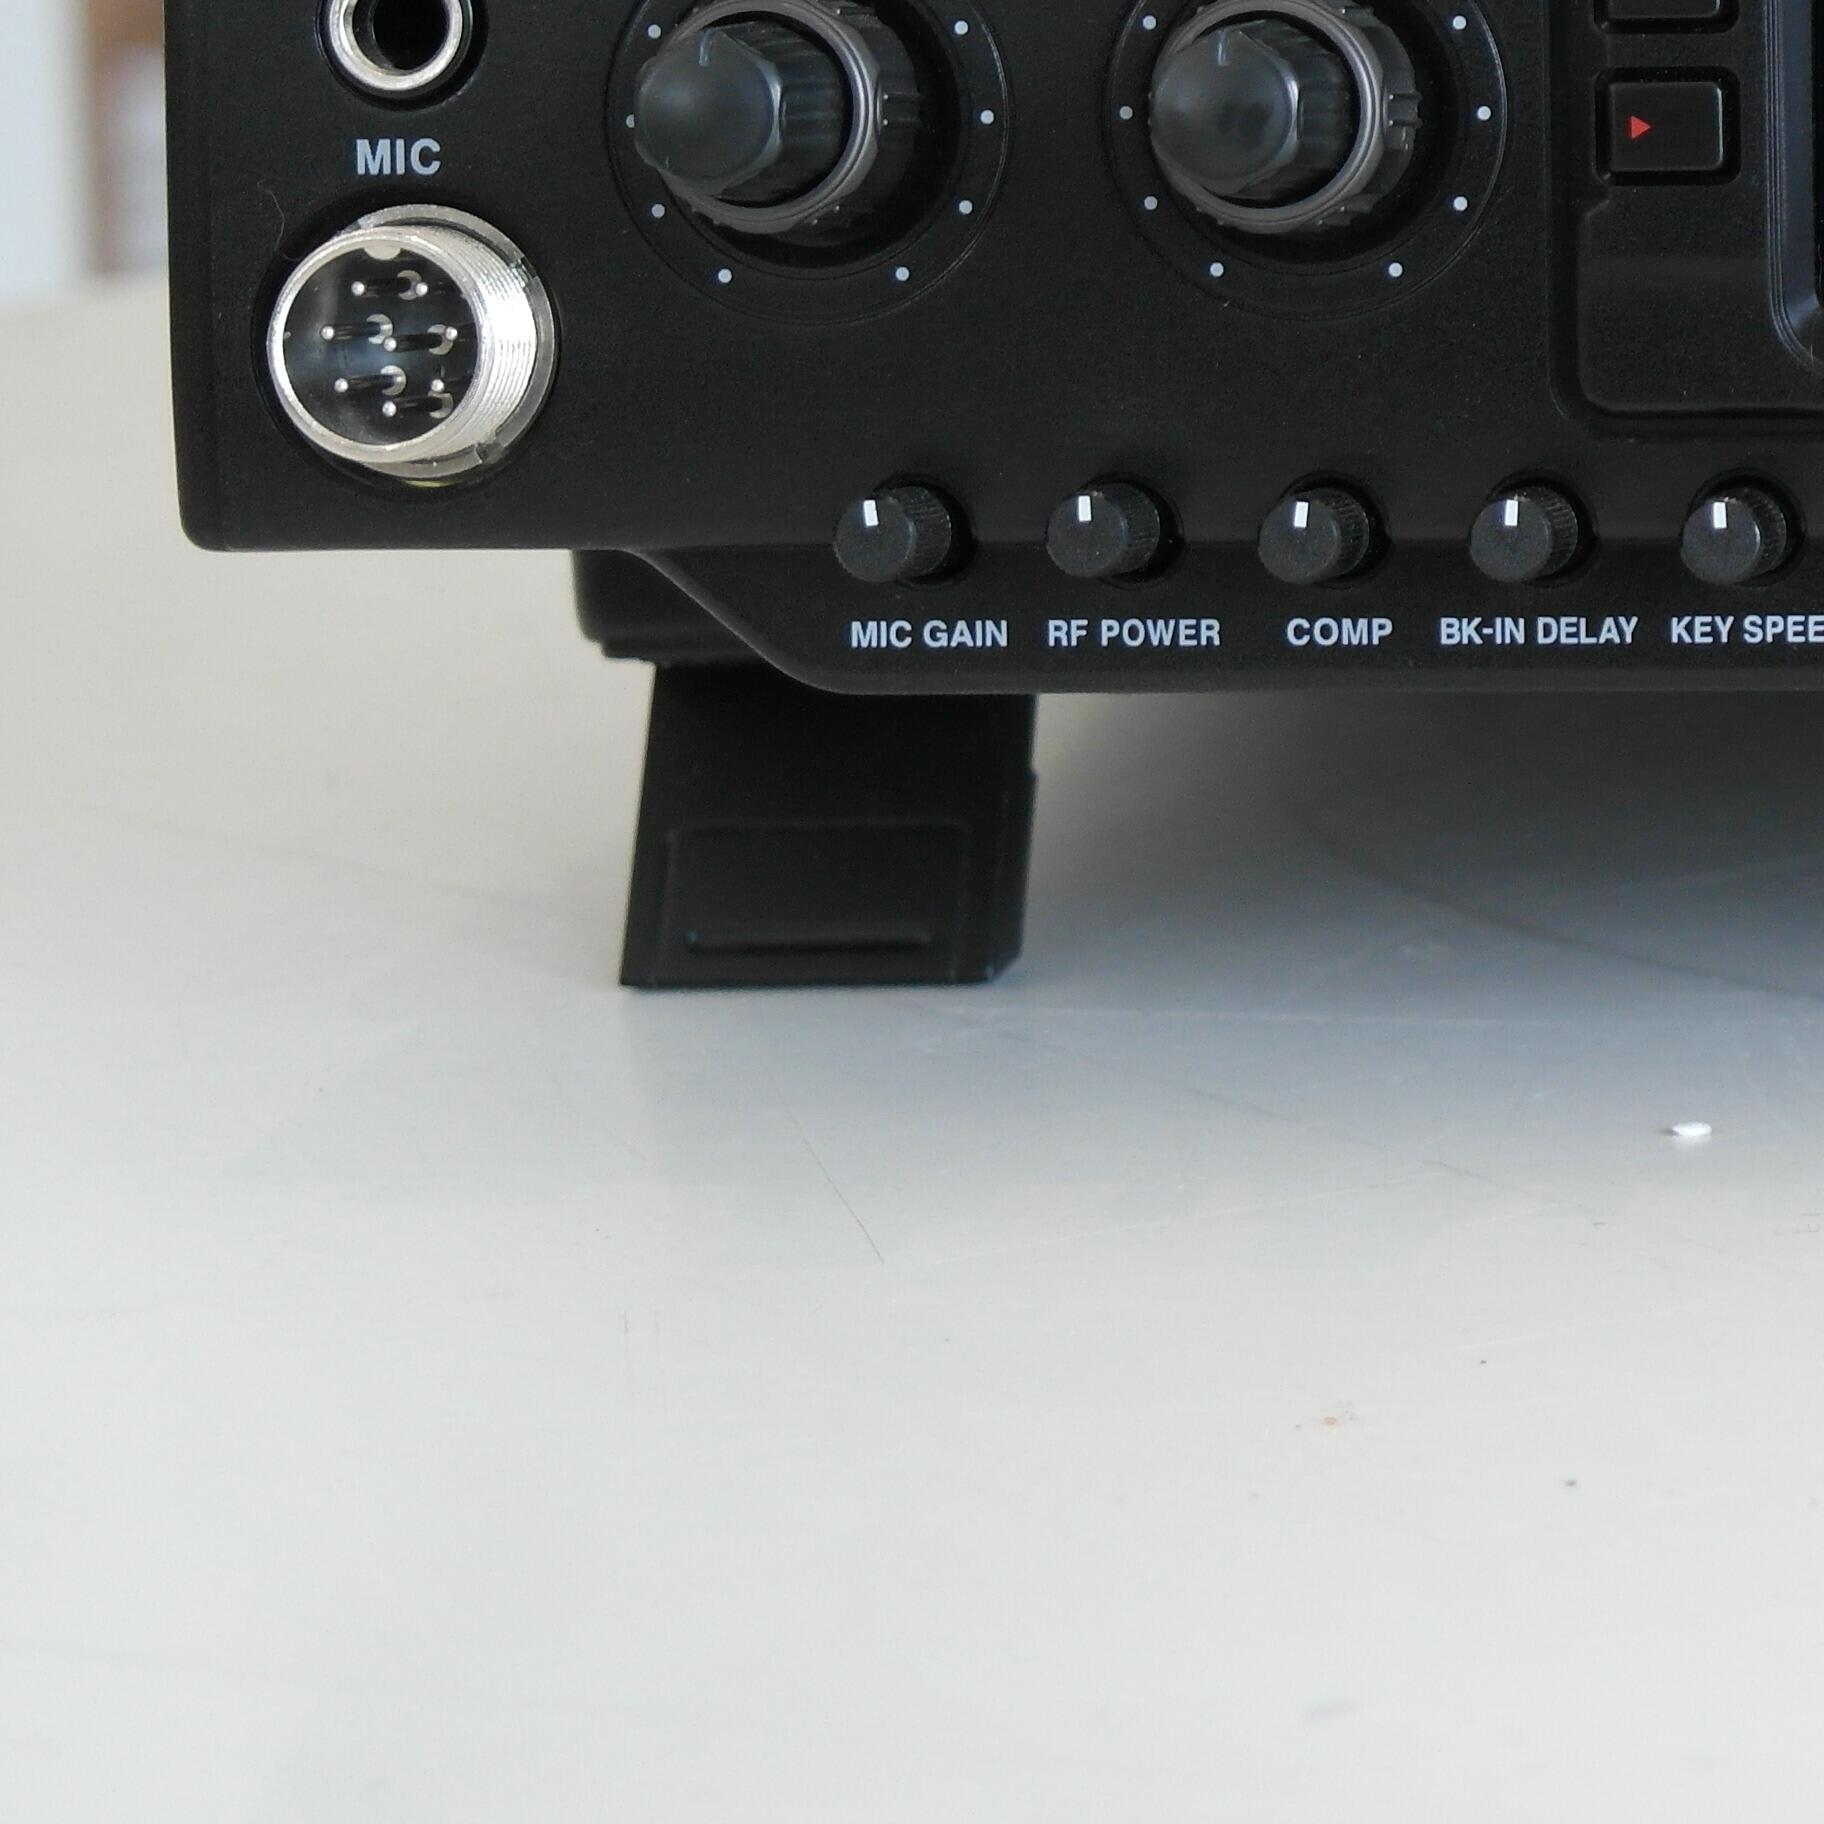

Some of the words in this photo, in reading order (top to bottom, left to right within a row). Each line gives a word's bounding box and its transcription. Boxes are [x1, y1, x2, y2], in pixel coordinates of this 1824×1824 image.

[356, 138, 441, 176] MIC
[851, 620, 912, 648] MIC
[923, 619, 1008, 648] GAIN
[1048, 619, 1089, 647] RF
[1101, 618, 1220, 647] POWER
[1286, 617, 1393, 646] COMP
[1440, 617, 1525, 645] BK-IN
[1537, 616, 1638, 645] DELAY
[1671, 615, 1735, 644] KEY
